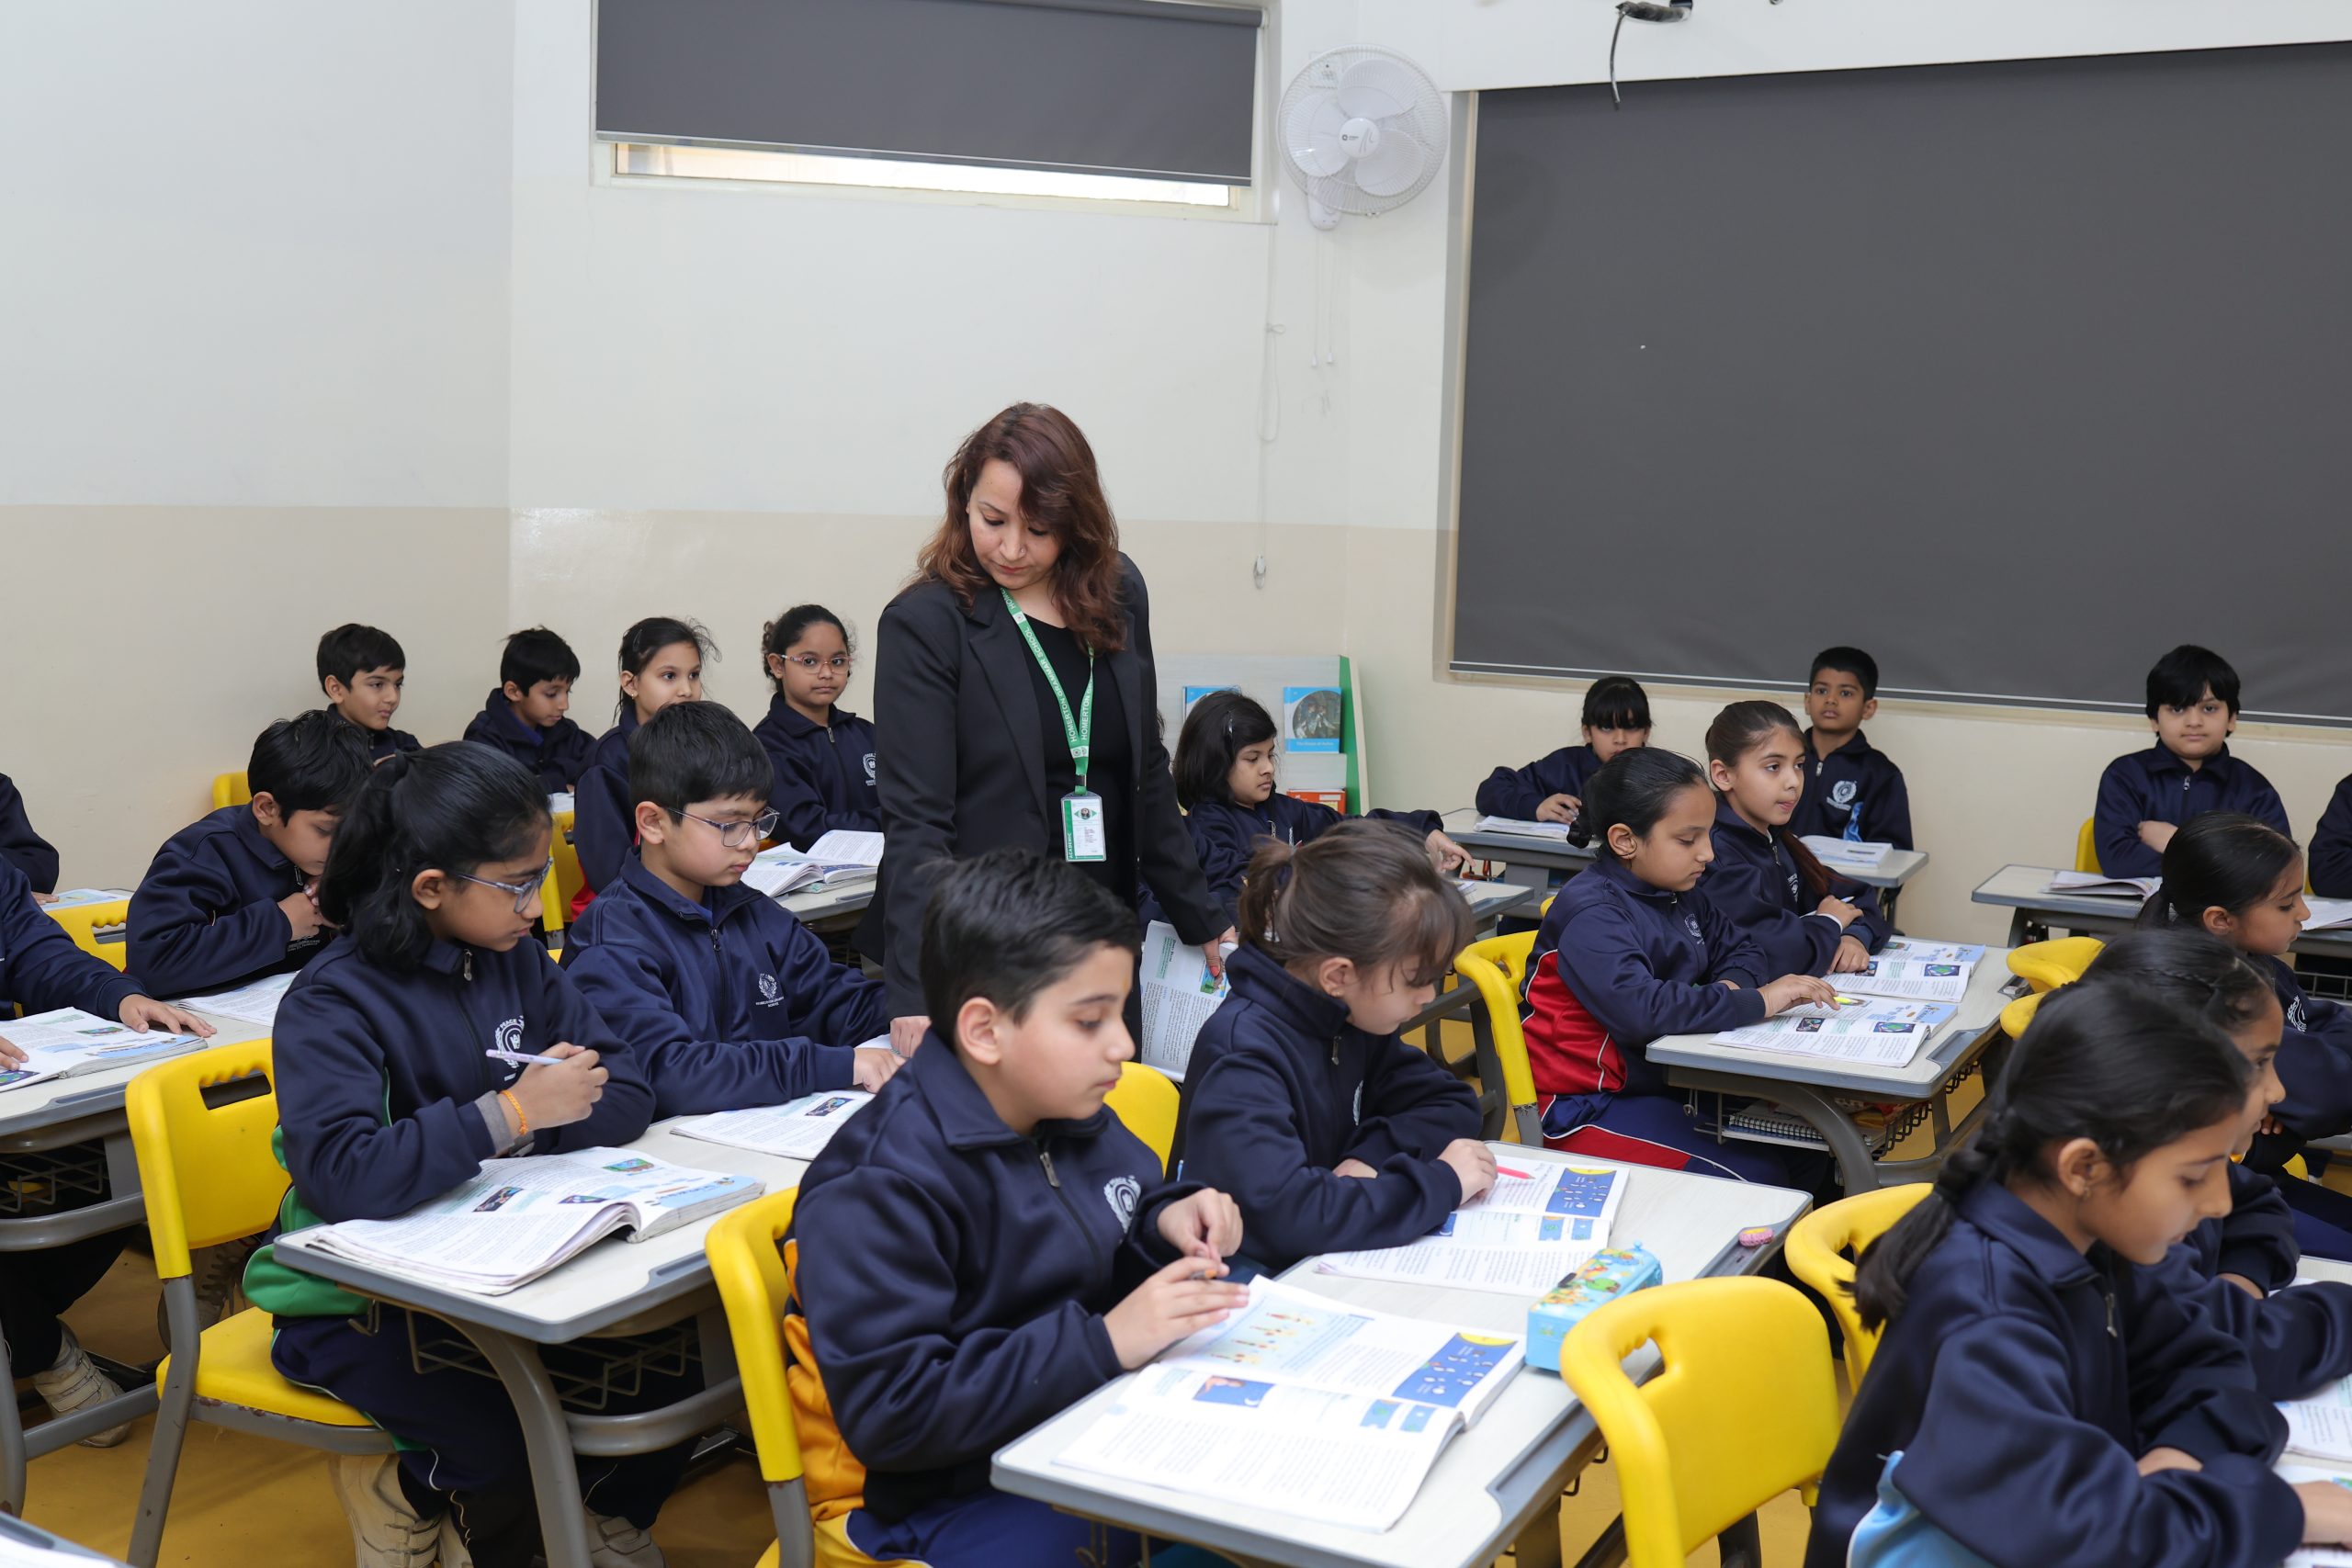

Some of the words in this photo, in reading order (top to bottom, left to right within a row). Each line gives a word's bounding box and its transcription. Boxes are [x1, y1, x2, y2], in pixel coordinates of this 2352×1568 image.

[1024, 627, 1043, 657] SCHOOL
[1040, 660, 1063, 697] GRAMMAR
[1059, 697, 1078, 742] HOMERTON
[1080, 694, 1091, 740] HOMERTON
[500, 1019, 517, 1029] PEACE
